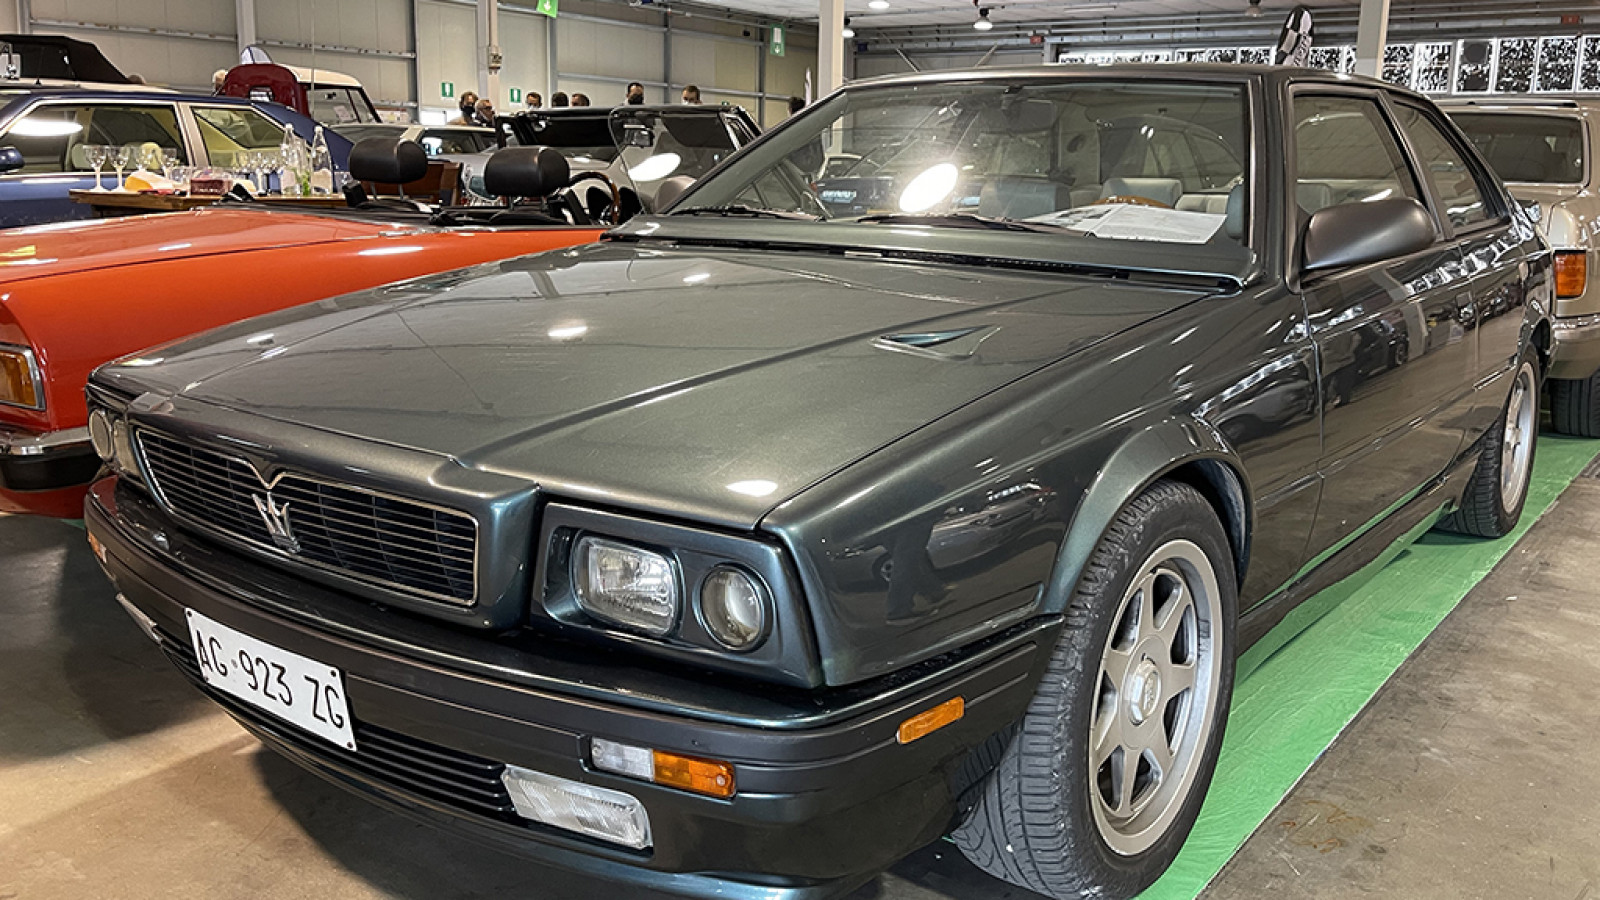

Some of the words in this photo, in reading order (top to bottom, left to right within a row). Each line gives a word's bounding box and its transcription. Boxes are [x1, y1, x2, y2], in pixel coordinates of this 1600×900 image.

[196, 629, 228, 677] AG
[238, 650, 292, 706] 923
[304, 675, 344, 729] ZG
